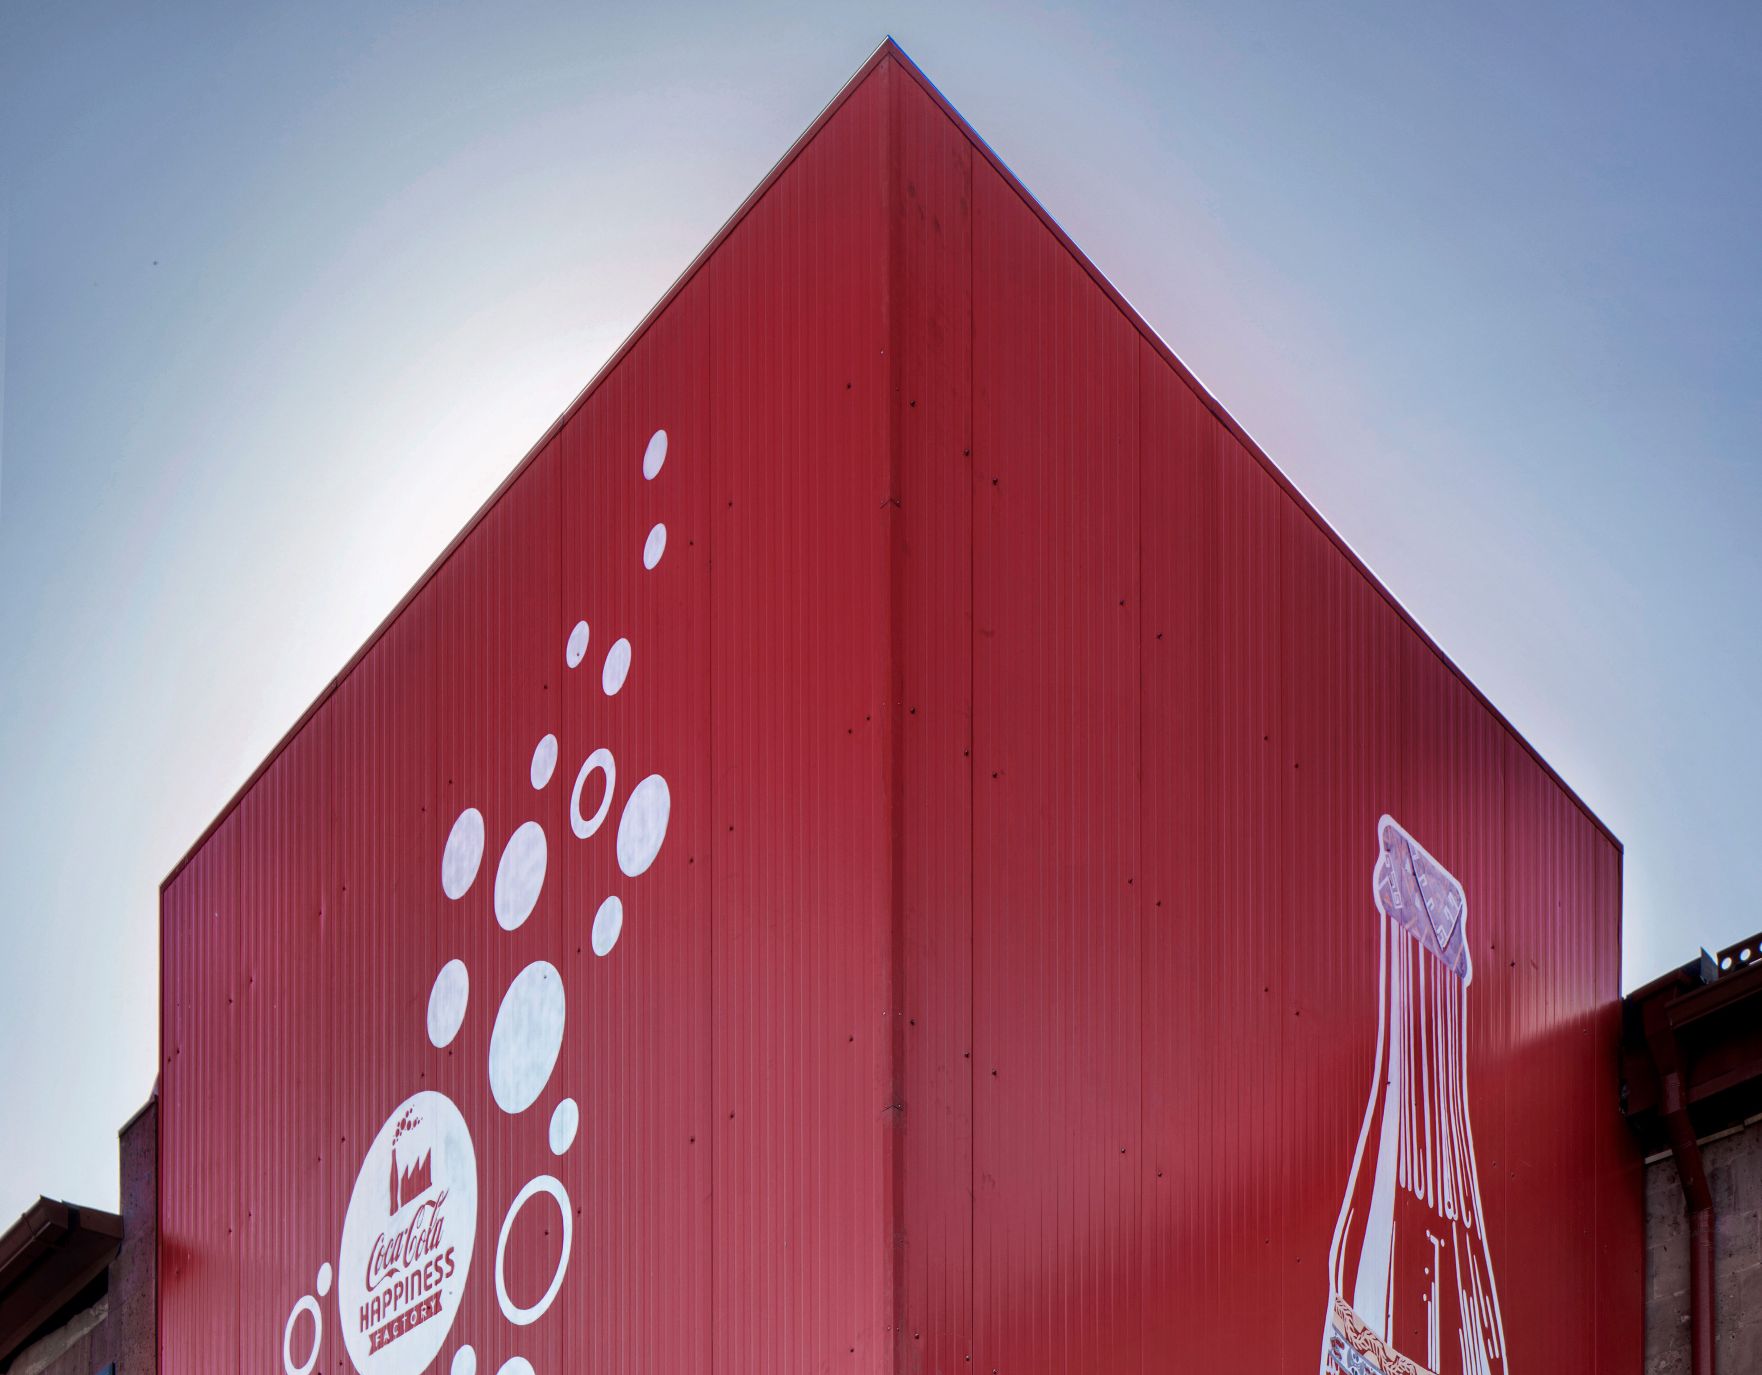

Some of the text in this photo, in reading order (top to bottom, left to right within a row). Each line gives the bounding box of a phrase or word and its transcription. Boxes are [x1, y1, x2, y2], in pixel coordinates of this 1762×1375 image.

[366, 1187, 449, 1292] Coca-Cola
[359, 1246, 455, 1333] HAPPINESS
[374, 1299, 438, 1347] FACTORY
